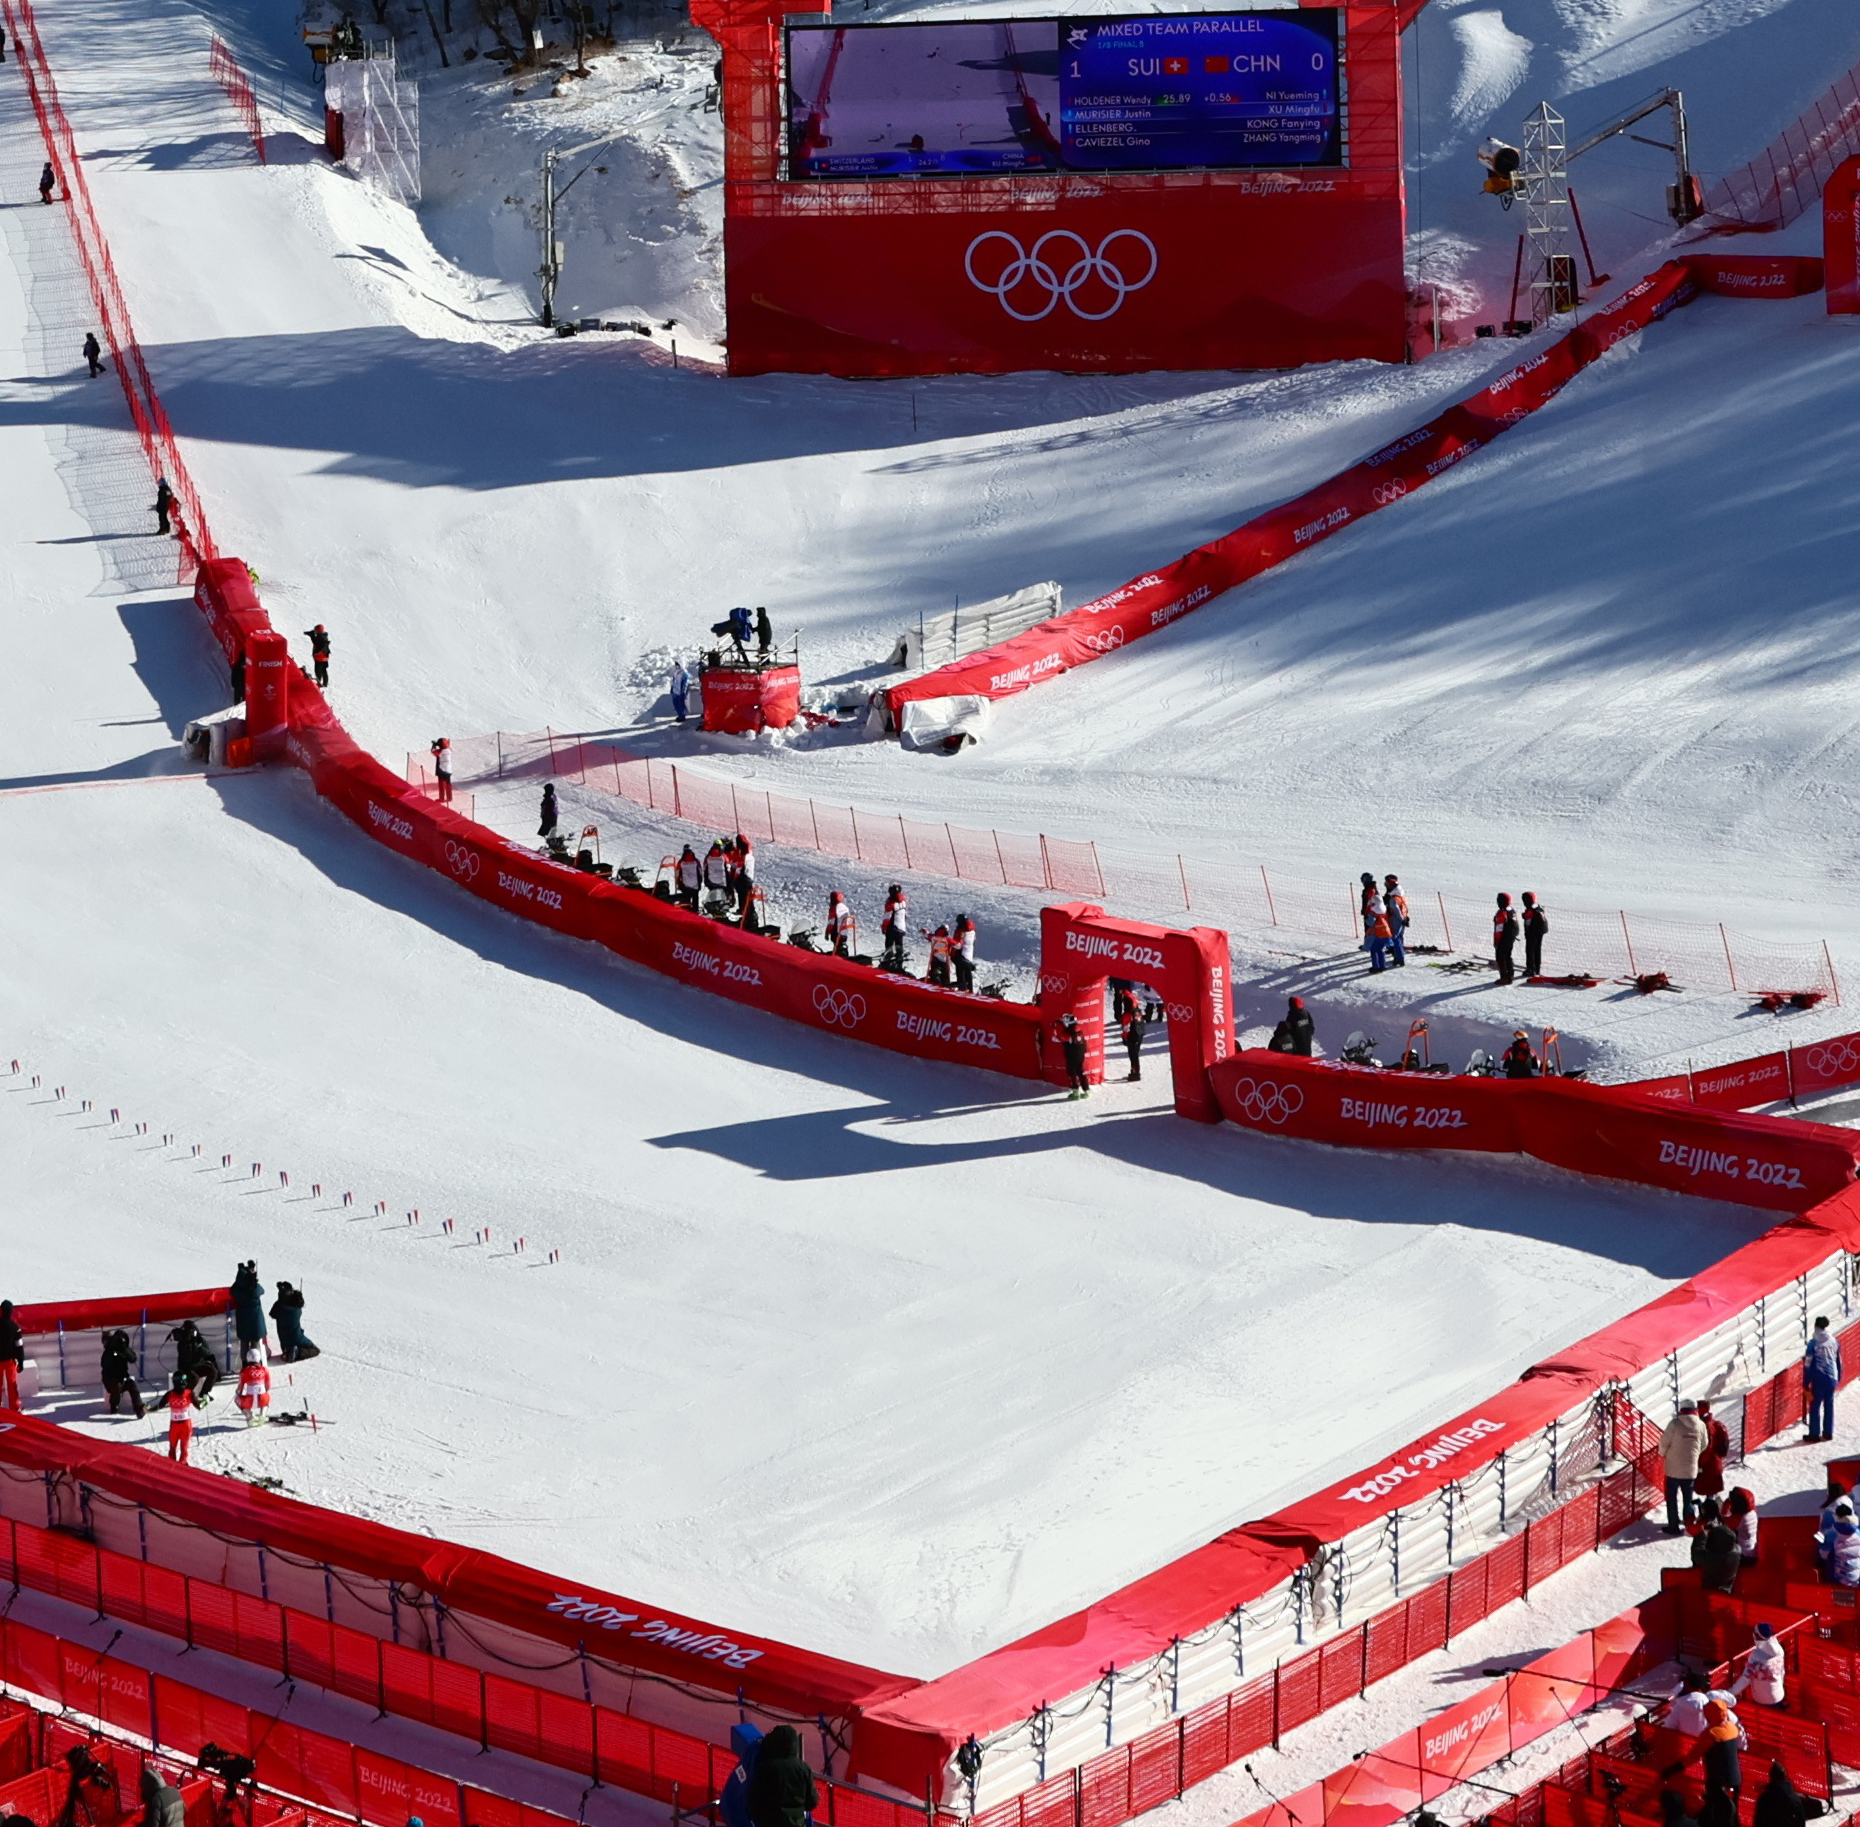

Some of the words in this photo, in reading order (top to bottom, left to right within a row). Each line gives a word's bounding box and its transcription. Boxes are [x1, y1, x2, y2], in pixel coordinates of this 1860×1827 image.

[1097, 23, 1143, 37] MIXED
[1146, 23, 1189, 35] TEAM
[1193, 20, 1264, 34] PARALLEL
[1070, 60, 1081, 78] 1
[1128, 58, 1160, 76] SUI
[1233, 55, 1280, 72] CHN
[1311, 53, 1324, 71] 0
[1075, 96, 1121, 105] HOLDENER
[1122, 95, 1151, 105] Wendy
[1163, 94, 1191, 103] 25.89
[1204, 93, 1231, 102] +0.56
[1266, 91, 1277, 100] NI
[1278, 90, 1320, 102] Yueming
[1268, 105, 1283, 114] XU
[1285, 104, 1320, 115] Mingfu
[1075, 110, 1122, 120] MURISIER
[1124, 109, 1151, 119] Justin
[1075, 123, 1137, 134] ELLENBERG.
[1247, 119, 1279, 129] KONG
[1282, 119, 1320, 131] Fanying
[1075, 137, 1124, 148] CAVIEZEL
[1126, 136, 1151, 146] Gino
[1243, 133, 1277, 143] ZHANG
[1279, 133, 1321, 144] Yangming
[1241, 182, 1291, 197] BEIJING
[1298, 180, 1337, 193] 2022
[1717, 272, 1758, 287] BEIJING
[1293, 517, 1326, 543] BEIJING
[1327, 506, 1351, 526] 2022
[1083, 589, 1133, 614] BEIJING
[1151, 599, 1185, 626] BEIJING
[1187, 585, 1212, 607] 2022
[258, 660, 283, 668] FINISH
[990, 665, 1031, 691] BEIJING
[1032, 653, 1064, 676] 2022
[368, 799, 393, 830] BEIJING
[391, 818, 413, 840] 2022
[498, 871, 534, 901] BEIJING
[537, 886, 562, 910] 2022
[672, 941, 720, 976] BEIJING
[723, 961, 763, 986] 2022
[1065, 931, 1118, 958] BEIJING
[1122, 942, 1165, 970] 2022
[1209, 965, 1225, 1026] BEIJING
[896, 1010, 952, 1042] BEIJING
[957, 1024, 1002, 1050] 2022
[1213, 1028, 1227, 1063] 202
[1646, 1087, 1684, 1100] 22
[1699, 1075, 1745, 1096] BEIJING
[1749, 1066, 1782, 1083] 2022
[1340, 1097, 1408, 1128] BEIJING
[1413, 1106, 1470, 1129] 2022
[1659, 1140, 1739, 1179] BEIJING
[1746, 1159, 1808, 1191] 2022
[1408, 1417, 1507, 1469] BEIJING
[1336, 1465, 1420, 1503] 2022
[546, 1592, 639, 1630] 2022
[630, 1619, 765, 1669] BEIJING
[64, 1656, 107, 1688] BEIJING
[111, 1676, 147, 1701] 2022
[1425, 1720, 1469, 1759] BEIJING
[1471, 1702, 1504, 1733] 2022
[359, 1765, 411, 1800] BEIJING
[415, 1787, 456, 1814] 2022
